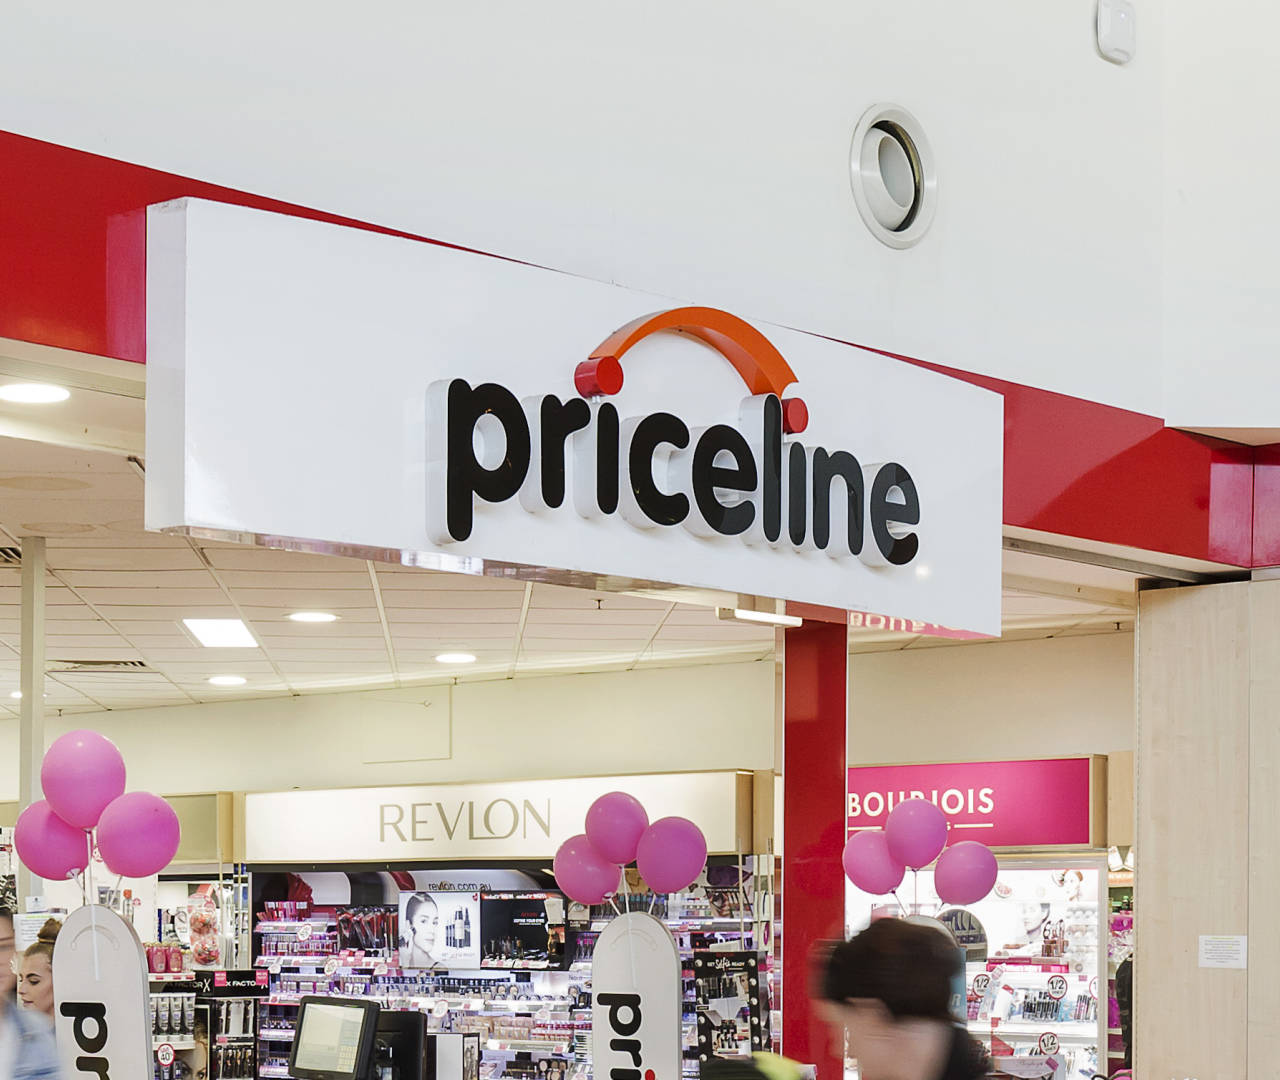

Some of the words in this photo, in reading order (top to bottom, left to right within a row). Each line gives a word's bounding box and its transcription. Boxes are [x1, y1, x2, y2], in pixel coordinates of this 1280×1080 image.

[446, 356, 920, 567] priceline
[379, 798, 551, 842] REVLON
[1050, 980, 1065, 991] 1/2
[1041, 1035, 1057, 1048] 1/2
